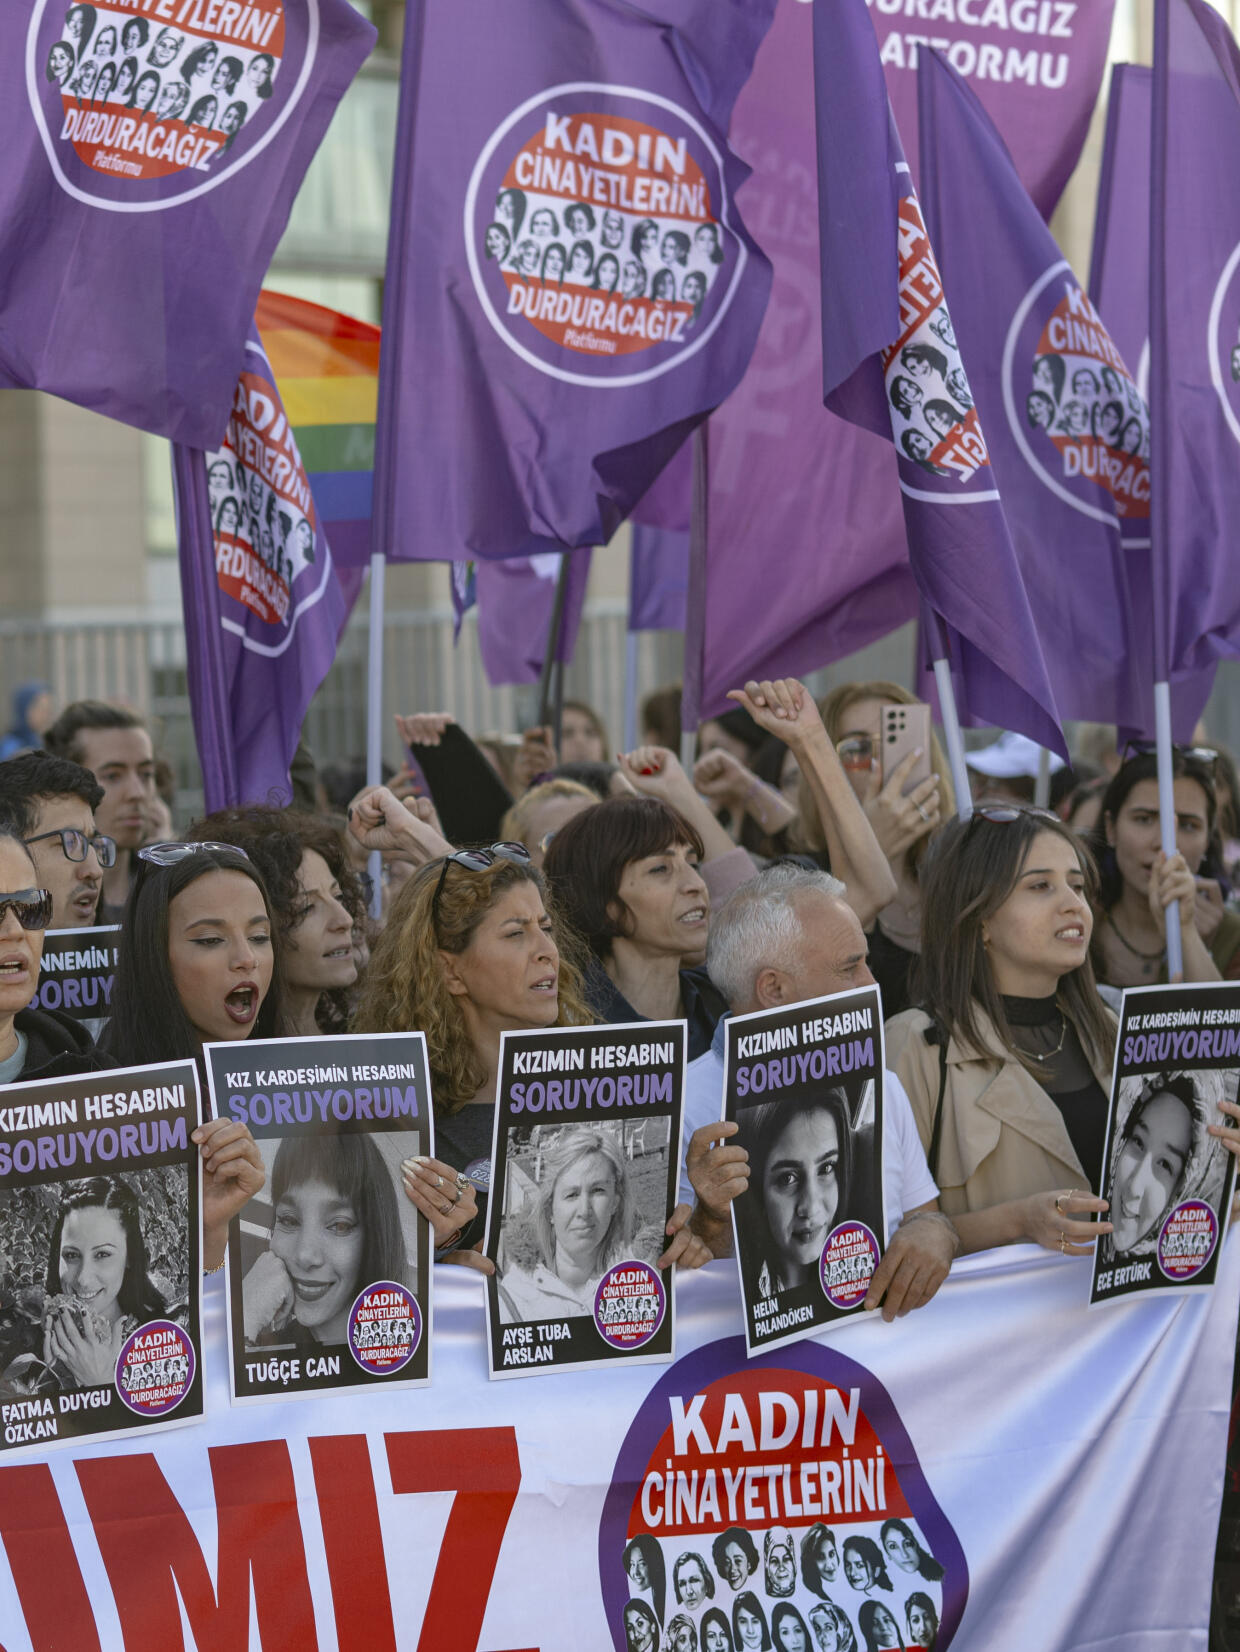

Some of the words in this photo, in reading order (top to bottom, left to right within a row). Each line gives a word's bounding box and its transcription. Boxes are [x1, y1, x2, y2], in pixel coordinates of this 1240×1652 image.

[60, 108, 221, 172] DURDURACAĞIZ
[544, 112, 687, 175] KADIN
[92, 151, 143, 177] Platformu
[515, 147, 706, 217] CİNAYETLERİNİ
[507, 284, 686, 343] DURDURACAĞIZ
[563, 329, 617, 353] Platformu
[737, 1025, 798, 1060] KIZIMIN
[802, 1008, 872, 1044] HESABINI
[1127, 1015, 1141, 1031] KIZ
[1142, 1008, 1201, 1028] KARDEŞİMİN
[513, 1048, 584, 1075] KIZIMIN
[590, 1042, 674, 1069] HESABINI
[1123, 1029, 1240, 1065] SORUYORUM
[225, 1071, 251, 1088] KIZ
[256, 1064, 347, 1087] KARDEŞİMİN
[352, 1063, 415, 1082] HESABINI
[736, 1037, 874, 1097] SORUYORUM
[84, 1084, 185, 1121] HESABINI
[228, 1085, 419, 1126] SORUYORUM
[510, 1072, 673, 1114] SORUYORUM
[1174, 1209, 1208, 1222] KADIN
[831, 1230, 864, 1249] KADIN
[603, 1281, 654, 1297] CİNAYETLERİNİ
[610, 1270, 649, 1285] KADIN
[1096, 1271, 1113, 1292] ECE
[1113, 1260, 1152, 1286] ERTÜRK
[357, 1303, 410, 1320] CİNAYETLERİNİ
[363, 1292, 403, 1308] KADIN
[753, 1297, 778, 1319] HELİN
[502, 1326, 533, 1348] AYŞE
[537, 1323, 571, 1342] TUBA
[755, 1304, 813, 1338] PALANDÖKEN
[127, 1340, 183, 1363] CİNAYETLERİNİ
[134, 1330, 176, 1349] KADIN
[503, 1345, 553, 1366] ARSLAN
[245, 1357, 300, 1385] TUĞÇE
[306, 1356, 340, 1377] CAN
[2, 1398, 54, 1423] FATMA
[59, 1389, 111, 1414] DUYGU
[130, 1383, 183, 1404] DURDURACAĞIZ
[4, 1415, 58, 1445] ÖZKAN
[669, 1387, 861, 1456] KADIN
[641, 1445, 888, 1528] CİNAYETLERİNİ
